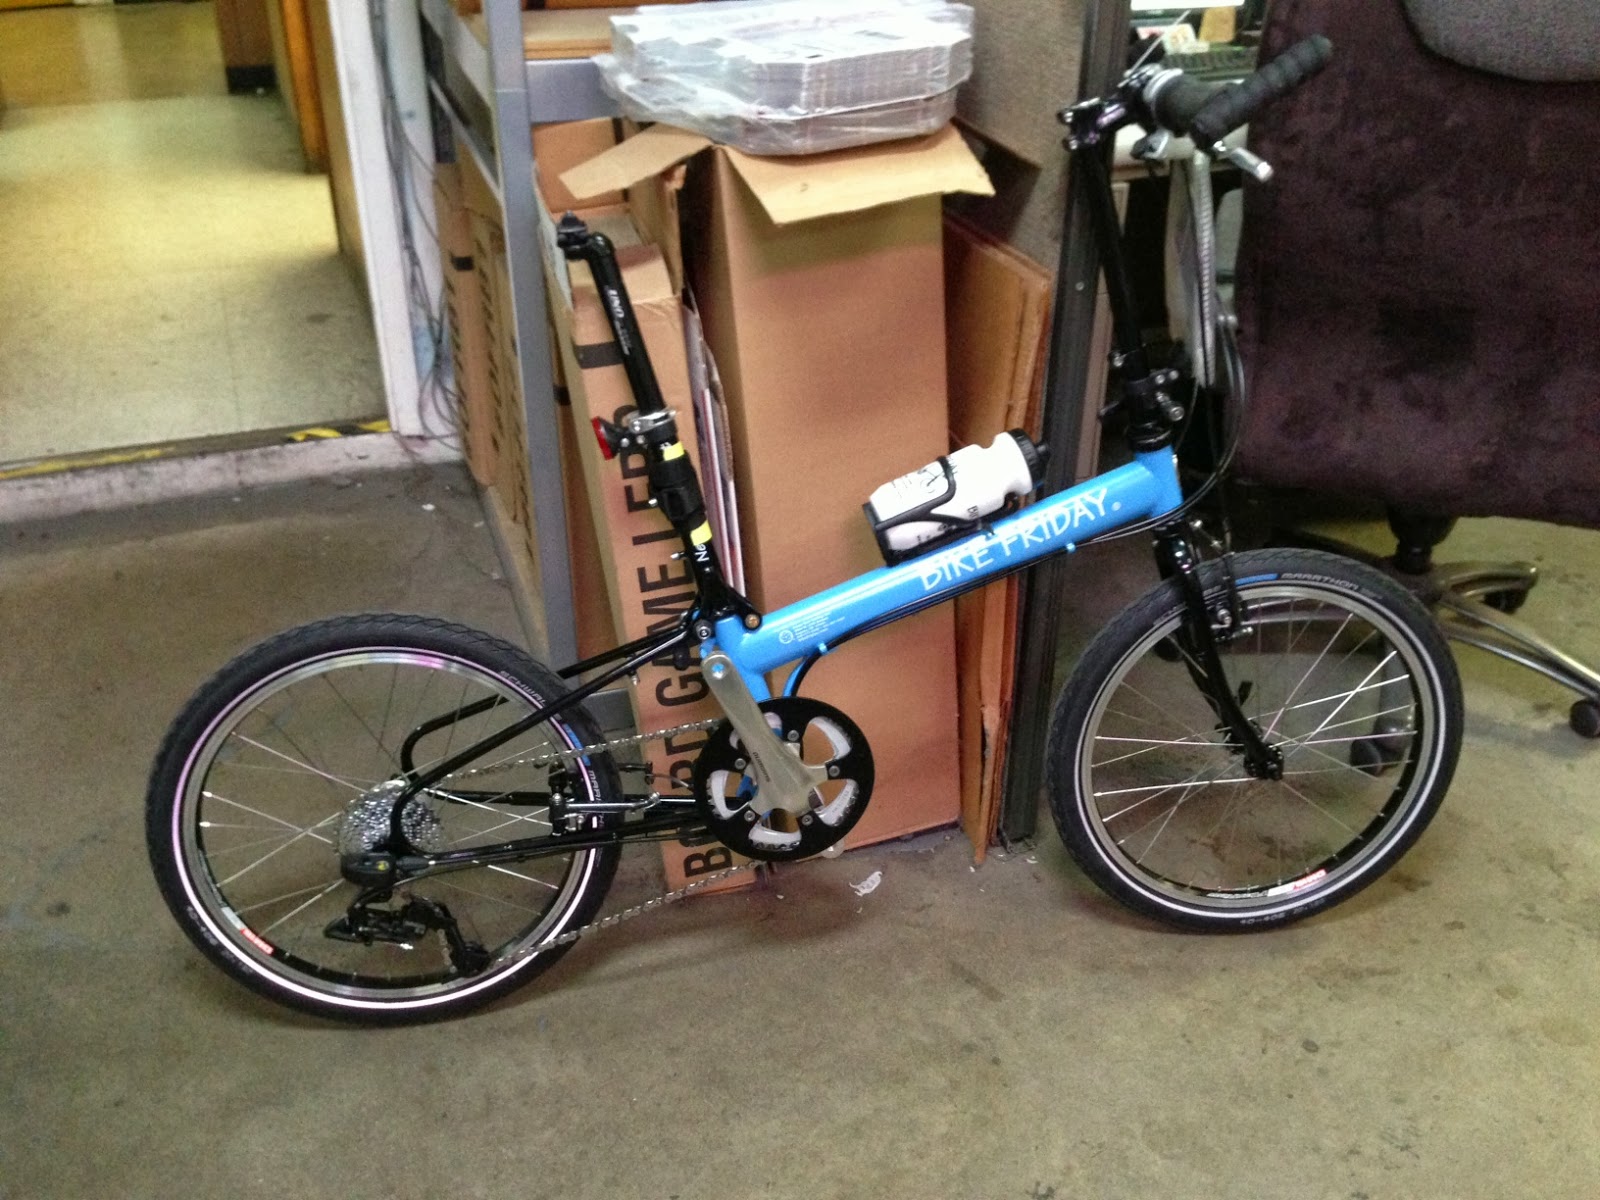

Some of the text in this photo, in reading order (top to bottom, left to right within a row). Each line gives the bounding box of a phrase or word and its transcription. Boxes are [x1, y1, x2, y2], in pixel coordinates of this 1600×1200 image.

[915, 488, 1108, 590] BIKE FRIDAY
[1280, 571, 1359, 590] MARATHON
